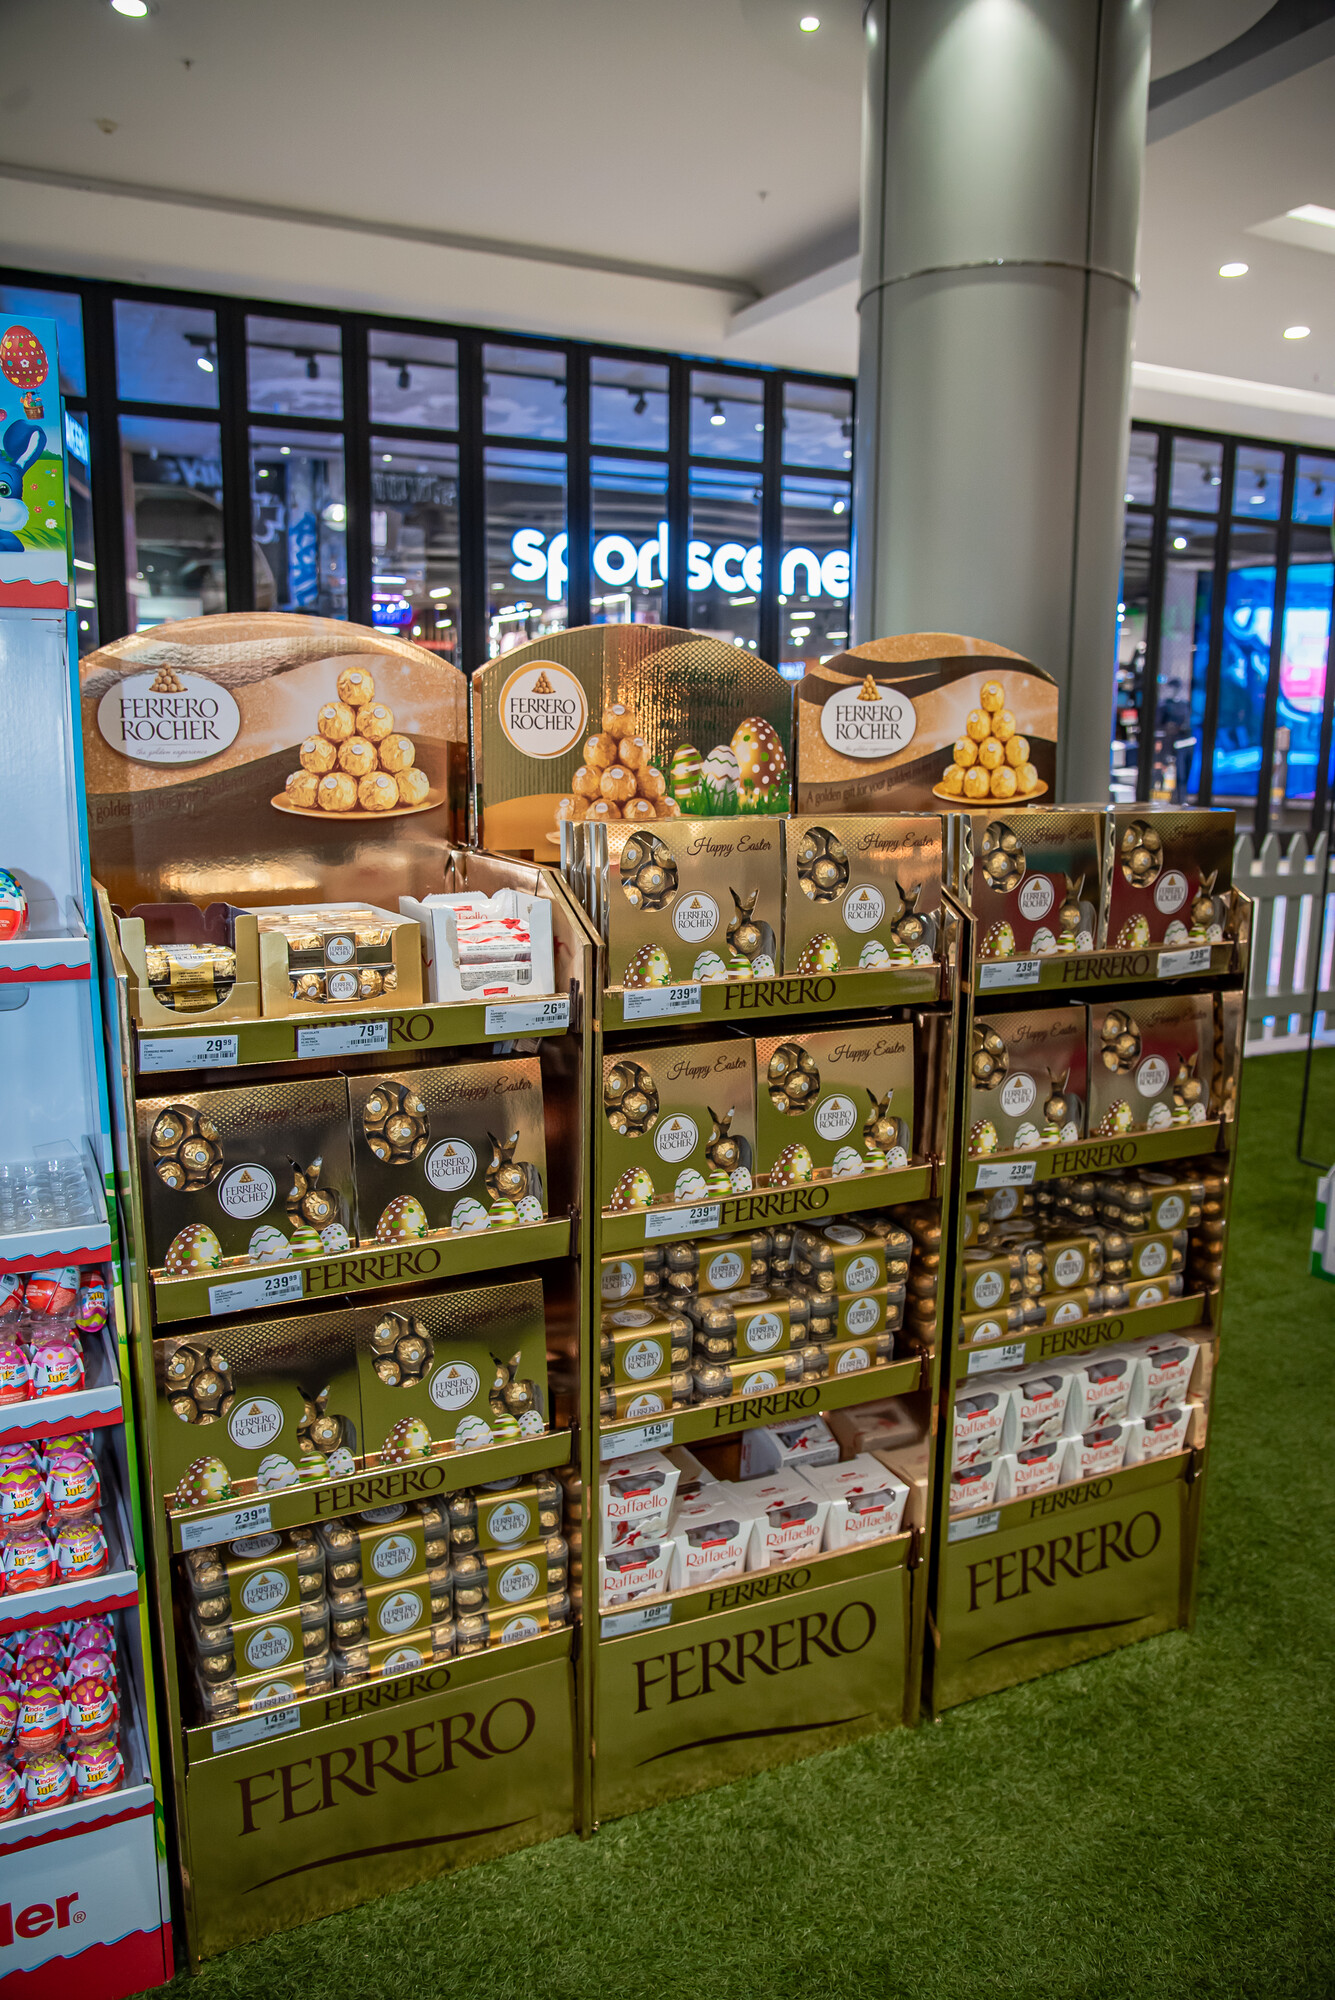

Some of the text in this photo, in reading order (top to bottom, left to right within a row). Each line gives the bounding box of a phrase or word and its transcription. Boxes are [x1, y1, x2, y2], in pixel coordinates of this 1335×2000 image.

[120, 698, 219, 718] FERRERO
[510, 697, 576, 714] FERRERO
[836, 705, 902, 722] FERRERO
[121, 720, 220, 740] ROCHER
[510, 714, 576, 731] ROCHER
[836, 723, 902, 740] ROCHER
[687, 835, 772, 857] Happy Easter
[857, 832, 934, 852] Happy Easter
[678, 910, 713, 920] FERRERO
[847, 902, 880, 911] FERRERO
[847, 910, 879, 920] ROCHER
[678, 919, 713, 929] ROCHER
[1062, 953, 1149, 983] FERRERO
[724, 976, 836, 1010] FERRERO
[828, 1039, 906, 1062] Happy Easter
[667, 1055, 746, 1081] Happy Easter
[493, 1076, 532, 1094] Easter
[819, 1110, 851, 1121] FERRERO
[819, 1118, 851, 1129] ROCHER
[659, 1130, 692, 1142] FERRERO
[659, 1139, 692, 1150] ROCHER
[431, 1156, 470, 1169] FERRERO
[1051, 1142, 1137, 1175] FERRERO
[431, 1165, 470, 1178] ROCHER
[225, 1182, 268, 1197] FERRERO
[225, 1191, 268, 1206] ROCHER
[720, 1186, 830, 1225] FERRERO
[304, 1247, 442, 1293] FERRERO
[1040, 1319, 1125, 1357] FERRERO
[435, 1377, 473, 1391] FERRERO
[435, 1385, 473, 1399] ROCHER
[714, 1386, 820, 1428] FERRERO
[1020, 1397, 1065, 1419] Raffaello
[235, 1414, 276, 1428] FERRERO
[235, 1422, 276, 1437] ROCHER
[954, 1416, 1002, 1437] Raffaello
[1015, 1459, 1060, 1483] Raffaello
[63, 1477, 86, 1486] kinder
[11, 1490, 34, 1499] kinder
[314, 1465, 446, 1516] FERRERO
[1030, 1478, 1113, 1519] FERRERO
[607, 1495, 668, 1518] Raffaello
[845, 1512, 898, 1531] Raffaello
[766, 1525, 820, 1546] Raffaello
[70, 1545, 93, 1554] kinder
[686, 1545, 743, 1567] Raffaello
[966, 1511, 1161, 1613] FERRERO
[604, 1568, 663, 1591] Raffaello
[246, 1582, 283, 1596] FERRERO
[247, 1590, 283, 1604] ROCHER
[708, 1568, 811, 1611] FERRERO
[250, 1638, 287, 1652] FERRERO
[251, 1645, 287, 1659] ROCHER
[633, 1601, 876, 1714] FERRERO
[324, 1668, 451, 1721] FERRERO
[79, 1703, 100, 1712] kinder
[85, 1763, 108, 1773] kinder
[233, 1697, 537, 1837] FERRERO
[35, 1775, 58, 1785] kinder
